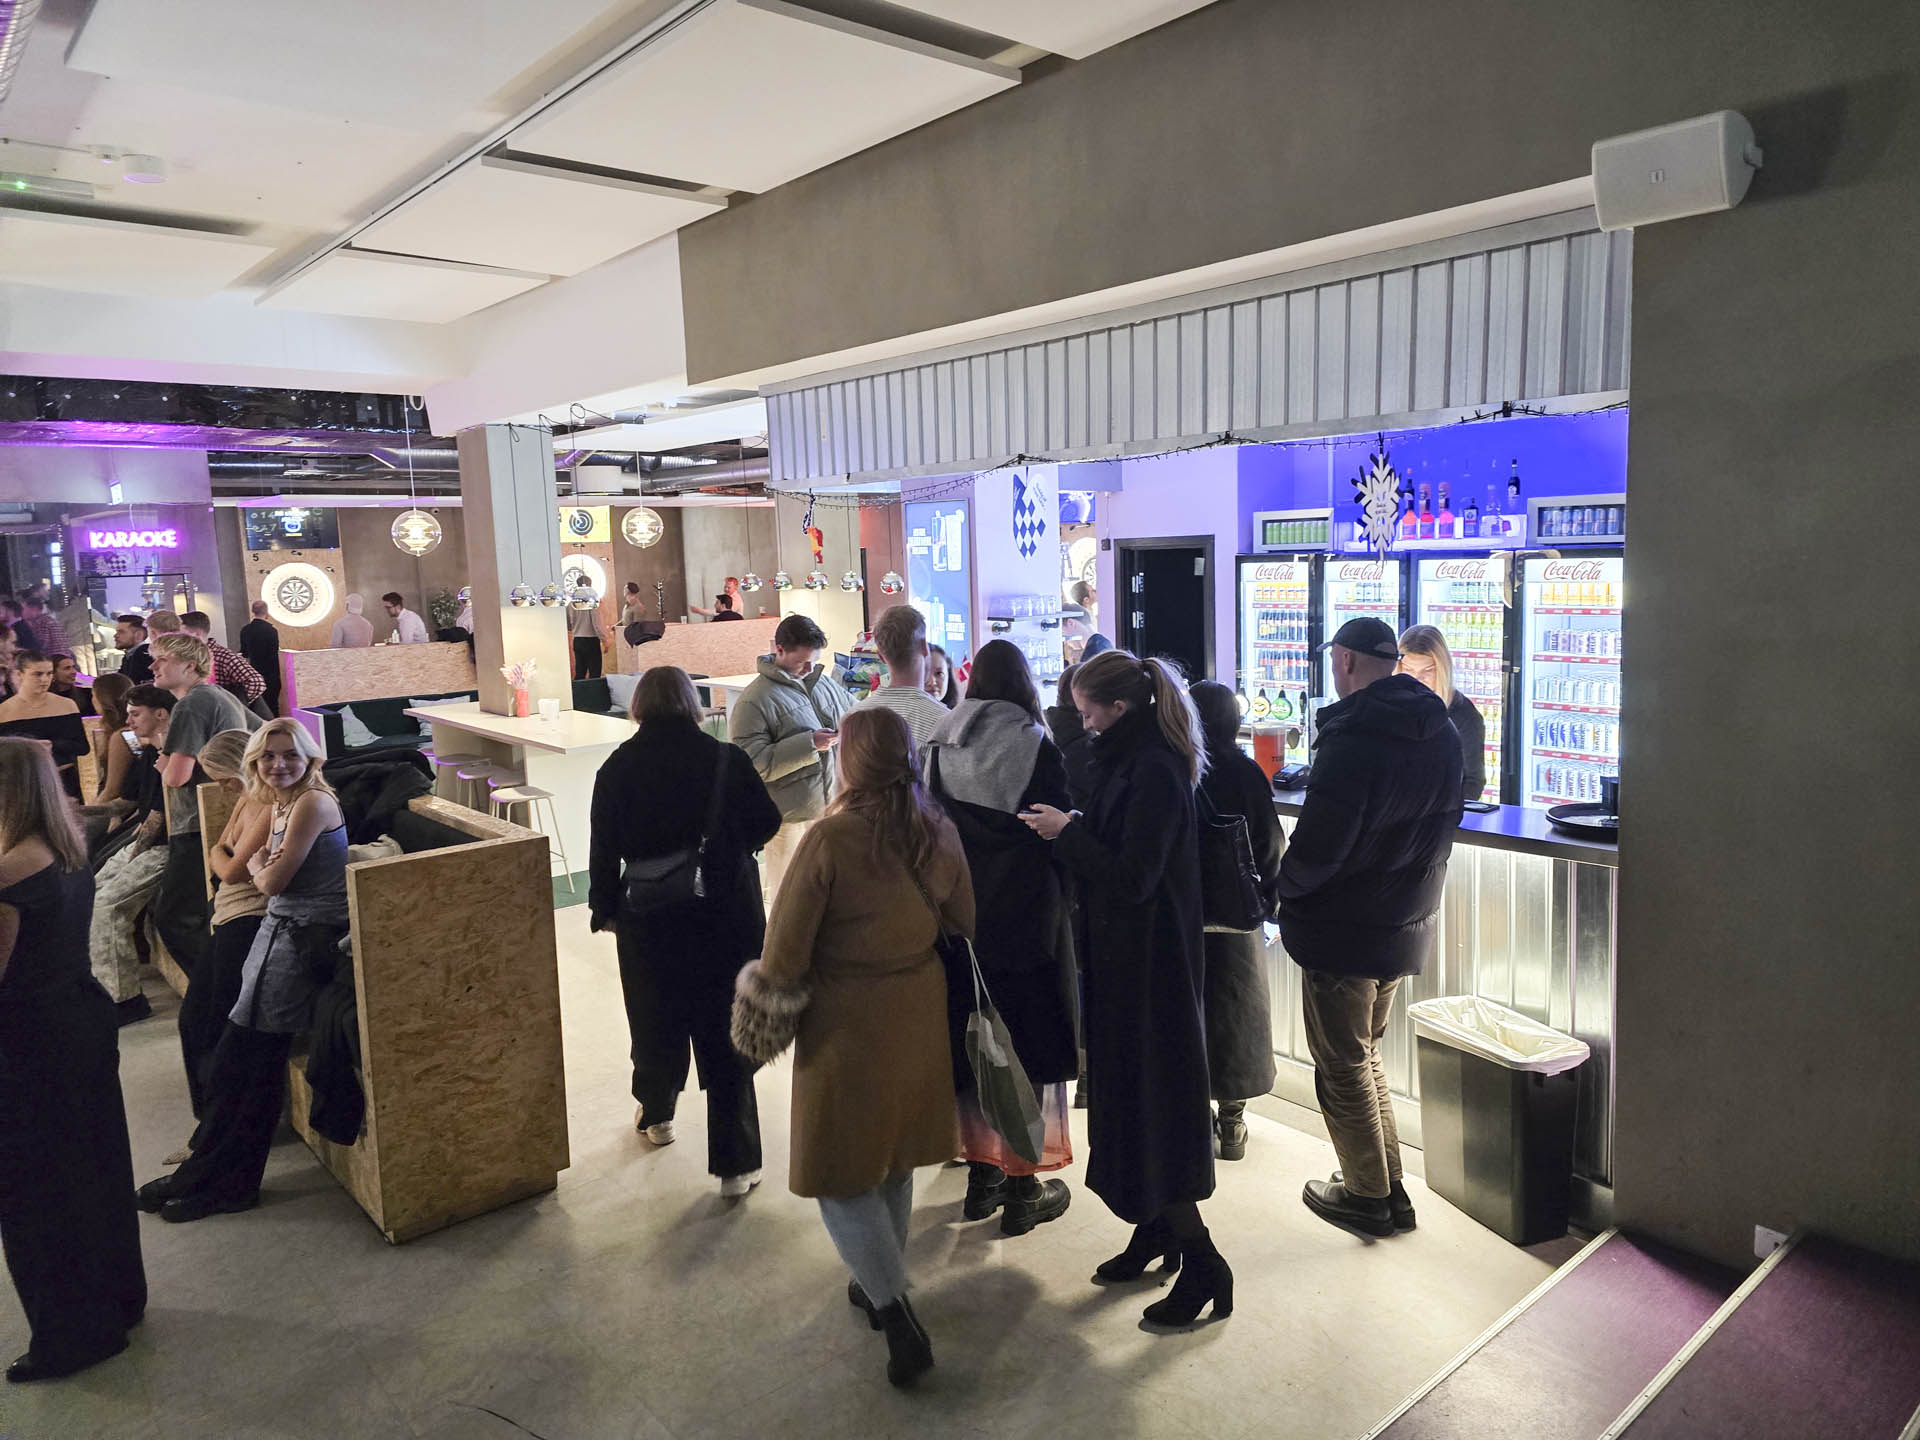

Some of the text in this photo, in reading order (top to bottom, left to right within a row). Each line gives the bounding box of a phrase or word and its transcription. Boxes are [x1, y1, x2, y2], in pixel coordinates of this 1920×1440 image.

[89, 529, 177, 548] KARAOKE
[252, 553, 259, 561] 5
[1543, 560, 1605, 580] Coca-Cola
